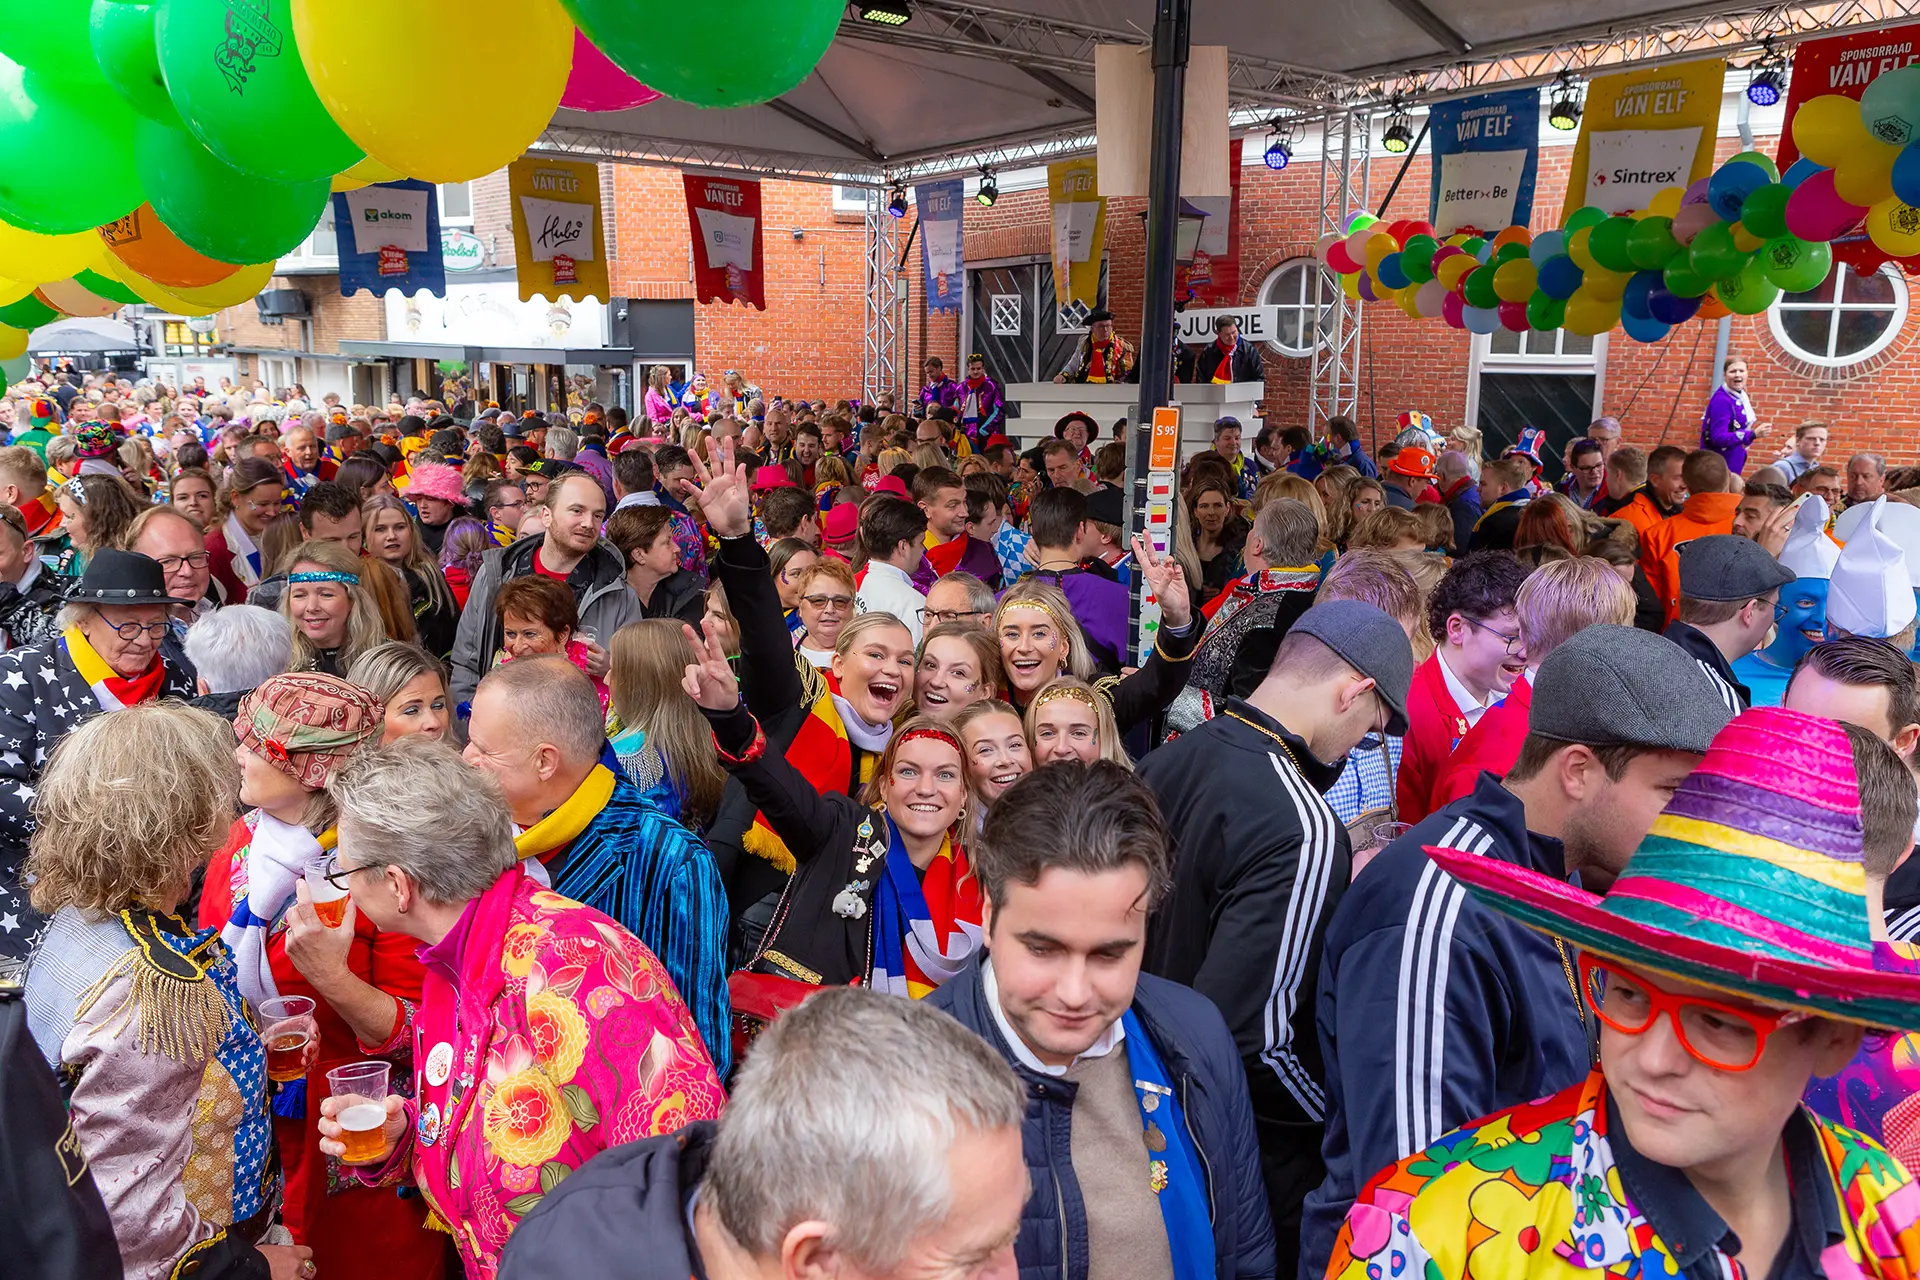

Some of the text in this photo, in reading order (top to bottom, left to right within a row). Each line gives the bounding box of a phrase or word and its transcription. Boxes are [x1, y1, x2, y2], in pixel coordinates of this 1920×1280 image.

[1840, 42, 1912, 62] SPONSORRAAD
[1829, 61, 1872, 88] VAN
[1624, 79, 1682, 96] SPONSORRAAD
[1461, 104, 1508, 120] SPONSORRAAD
[1614, 90, 1688, 118] VAN ELF
[1456, 115, 1512, 142] VAN ELF
[532, 176, 579, 193] VAN ELF
[1076, 176, 1093, 192] ELF
[1612, 168, 1677, 184] Sintrex
[704, 189, 744, 207] VAN ELF
[1445, 185, 1508, 203] Better Be
[940, 197, 952, 211] ELF
[380, 209, 412, 221] akom
[537, 214, 582, 248] Hubo
[1156, 424, 1175, 436] S 95
